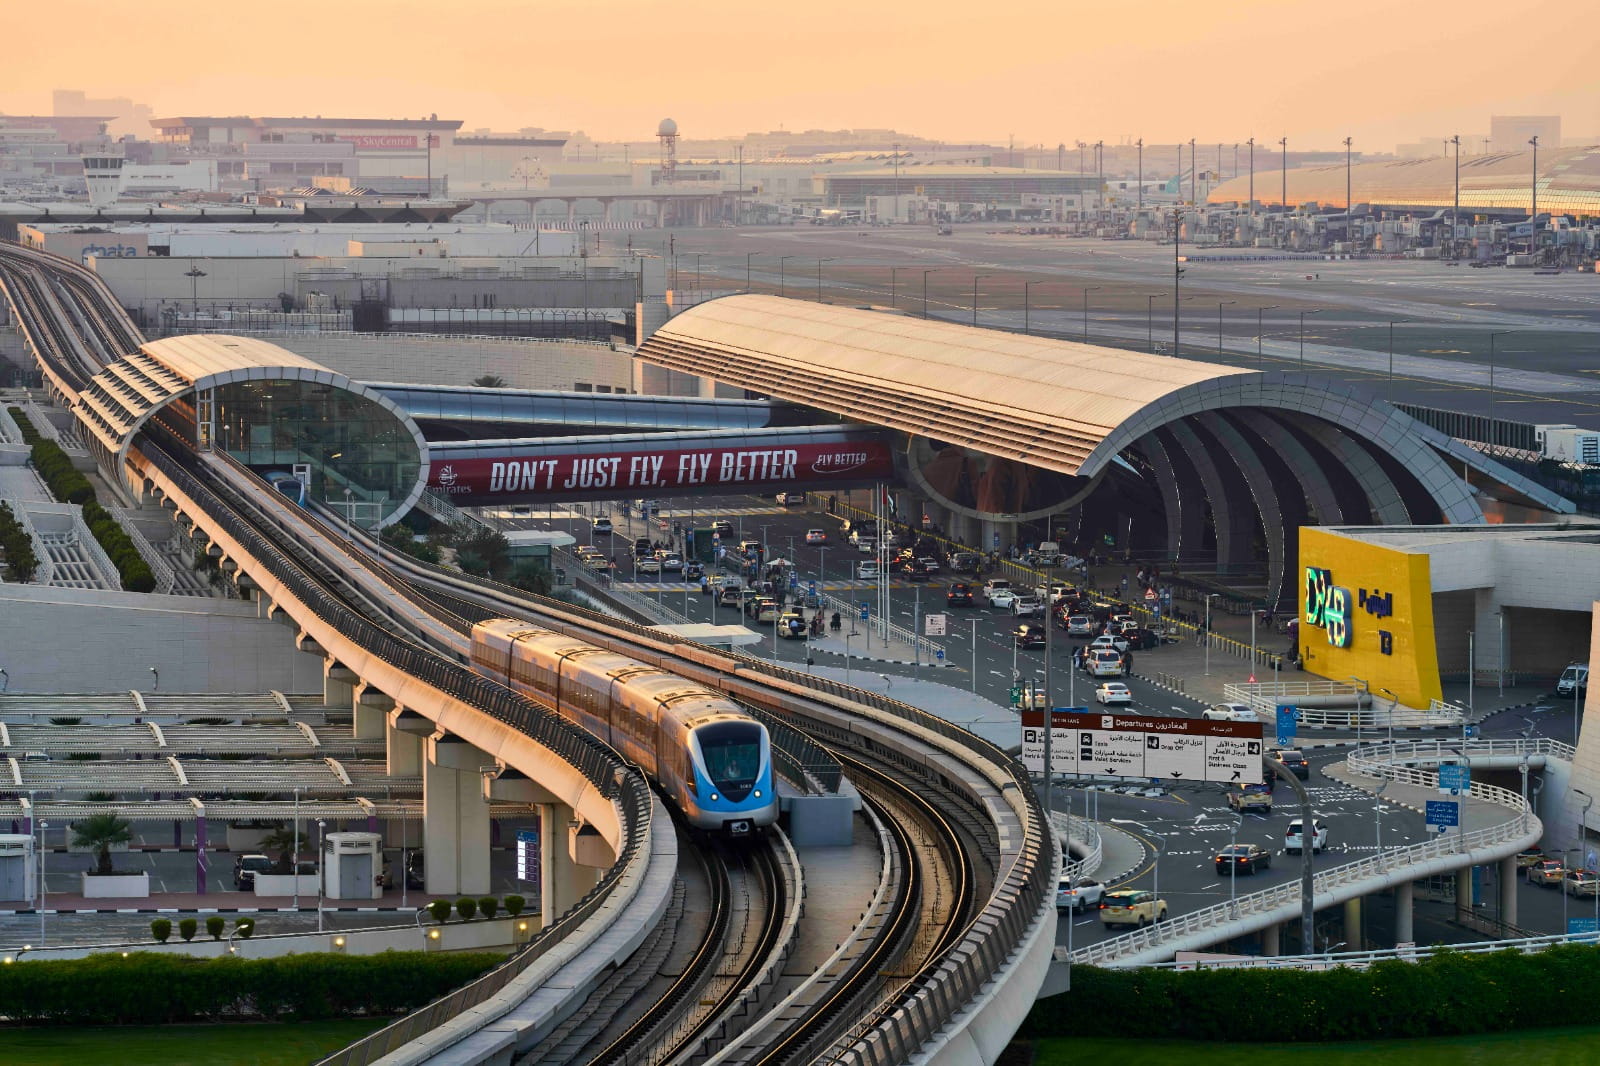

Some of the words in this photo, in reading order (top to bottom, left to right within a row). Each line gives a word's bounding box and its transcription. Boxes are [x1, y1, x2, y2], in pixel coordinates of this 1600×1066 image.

[82, 243, 136, 257] dnata
[816, 454, 833, 466] FLY
[835, 452, 867, 465] BETTER
[489, 459, 559, 492] DON'T
[564, 456, 622, 489] JUST
[628, 455, 667, 487] FLY,
[676, 453, 713, 485] FLY
[719, 450, 798, 482] BETTER
[425, 485, 472, 494] Emirates
[1116, 719, 1154, 728] Departures
[1155, 721, 1188, 730] المغادرون
